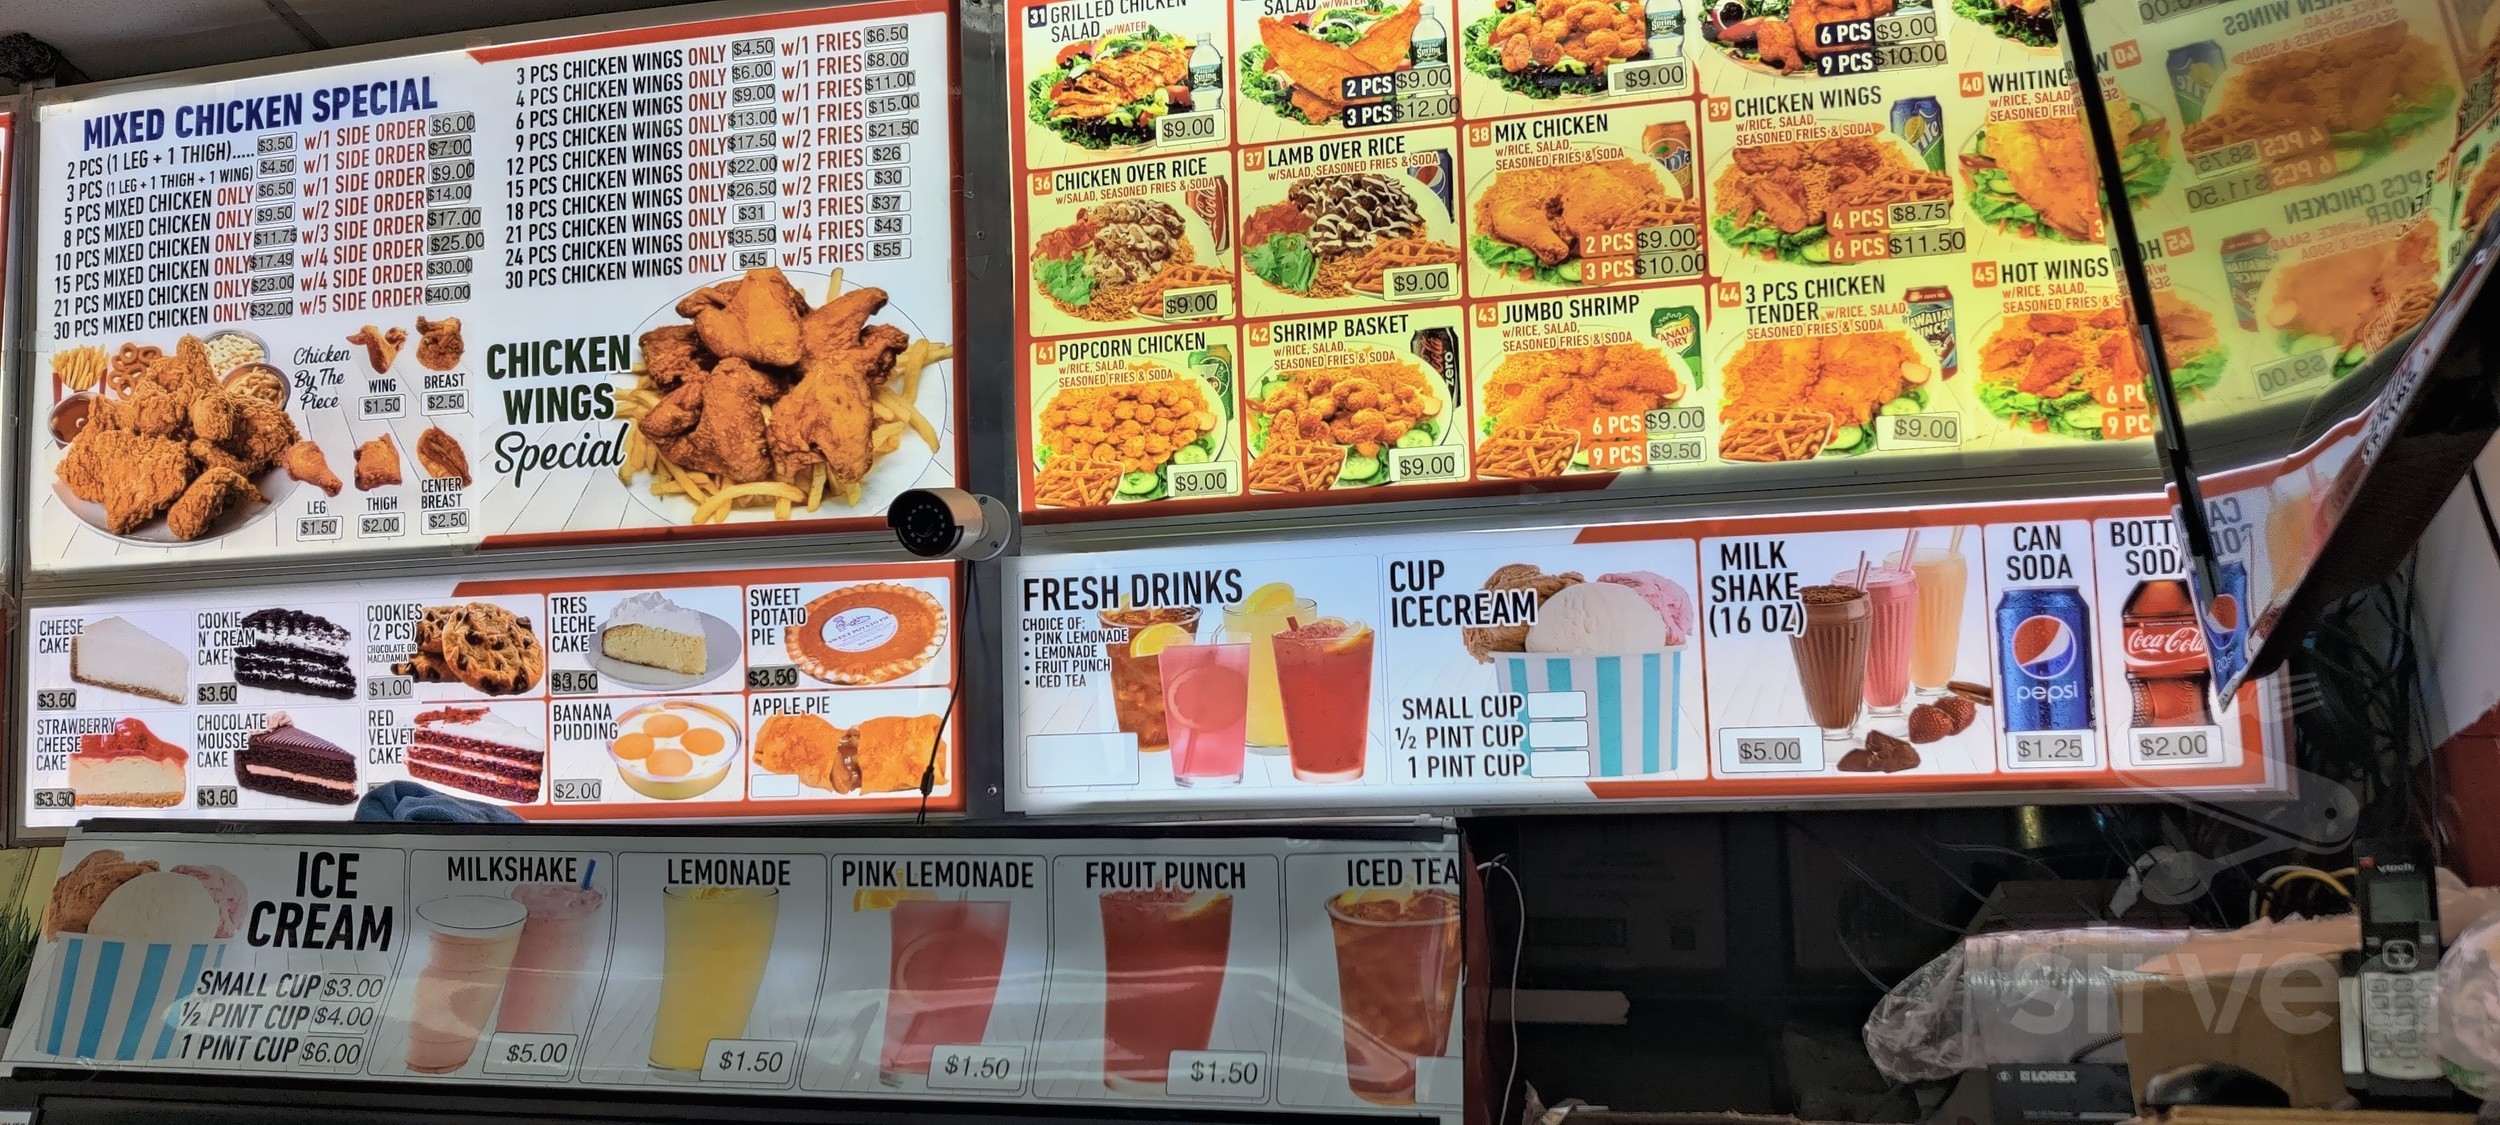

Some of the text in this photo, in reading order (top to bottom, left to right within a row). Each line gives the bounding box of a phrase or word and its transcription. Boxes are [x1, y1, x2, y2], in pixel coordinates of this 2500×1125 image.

[1029, 1, 1113, 24] 31 GRILLED
[1051, 21, 1147, 43] SALAD w/WATER
[516, 25, 907, 84] 3 PCS CHICKEN WINGS ONLY $4.50 w/1 FRIES $6.50
[1962, 77, 1981, 93] 40
[1711, 86, 1881, 118] 39 CHICKEN WINGS
[1989, 93, 2030, 108] w/RICE,
[83, 75, 438, 152] MIXED CHICKEN SPECIAL
[1736, 115, 1817, 133] w/RICE, SALAD,
[1163, 117, 1215, 138] $9.00
[1472, 114, 1608, 143] 38 MIX CHICKEN
[1736, 123, 1872, 146] SEASONED FRIES & SODA
[67, 162, 75, 180] 2
[79, 158, 102, 177] PCS
[107, 155, 118, 176] (1
[123, 151, 148, 172] LEG
[153, 153, 162, 164] +
[168, 149, 174, 165] 1
[258, 135, 293, 153] $3.50
[304, 128, 330, 151] w/1
[337, 124, 370, 147] SIDE
[375, 119, 425, 143] ORDER
[432, 114, 475, 133] $6.00
[1034, 157, 1207, 192] 36 CHICKEN OVER RICE
[64, 161, 474, 225] 5 PCS MIXED CHICKEN ONLY $6.50 w/1 SIDE ORDER $9.00
[1056, 177, 1215, 205] w/SALAD, SEASONED FRIES & SODA
[1833, 205, 1945, 229] 4 PCS $8.75
[1975, 258, 2109, 283] 45 HOT WINGS
[1720, 275, 1885, 303] 44 3 PCS CHICKEN
[1166, 295, 1218, 317] $9.00
[1477, 295, 1640, 324] 43 JUMBO SHRIMP
[1747, 302, 1818, 325] TENDER
[1250, 315, 1408, 344] 42 SHRIMP BASKET
[293, 344, 351, 366] Chicken
[487, 334, 631, 380] CHICKEN
[1038, 332, 1205, 361] 41 POPCORN CHICKEN
[294, 367, 345, 394] By The
[368, 379, 396, 393] WING
[424, 373, 465, 389] BREAST
[301, 389, 340, 411] Piece
[427, 394, 464, 410] $2.50
[503, 382, 614, 426] WINGS
[1593, 411, 1704, 435] 6 PCS $9.00
[1895, 419, 1958, 439] $9.00
[494, 423, 629, 488] Special
[307, 501, 326, 515] LEG
[301, 520, 337, 535] $1.50
[2013, 525, 2062, 551] CAN
[1721, 541, 1787, 571] MILK
[1389, 560, 1445, 593] CUP
[2006, 555, 2073, 581] SODA
[1023, 568, 1242, 612] FRESH DRINKS
[1710, 572, 1799, 603] SHAKE
[366, 602, 422, 622] COOKIES
[1391, 592, 1536, 628] ICECREAM
[1709, 601, 1807, 637] (16 OZ)
[39, 619, 84, 636] CHEESE
[367, 622, 415, 641] (2 PCS)
[1022, 617, 1085, 632] CHOICE OF:
[39, 637, 70, 654] CAKE
[1034, 628, 1128, 645] PINK LEMONADE
[366, 643, 417, 654] CHOCOLATE OR
[366, 653, 408, 663] MACADAMIA
[369, 680, 411, 697] $1.00
[2016, 681, 2078, 703] pepsi
[553, 703, 612, 722] BANANA
[752, 696, 830, 716] APPLE PIE
[36, 716, 116, 736] STRAWBERRY
[553, 722, 618, 741] PUDDING
[1739, 741, 1800, 761] $5.00
[2017, 737, 2082, 760] $1.25
[2141, 735, 2208, 758] $2.00
[555, 782, 601, 800] $2.00
[295, 851, 360, 899] ICE
[448, 856, 577, 883] MILKSHAKE
[667, 859, 791, 886] LEMONADE
[1086, 861, 1246, 889] FRUIT PUNCH
[1348, 858, 1459, 887] ICED TEA
[246, 901, 393, 952] CREAM
[197, 970, 382, 1000] SMALL CUP $3.00
[180, 1034, 361, 1063] 1 PINT CUP $6.00
[506, 1043, 567, 1063] $5.00
[719, 1051, 782, 1072] $1.50
[1191, 1061, 1258, 1083] $1.50
[2031, 1070, 2077, 1083] LOREX
